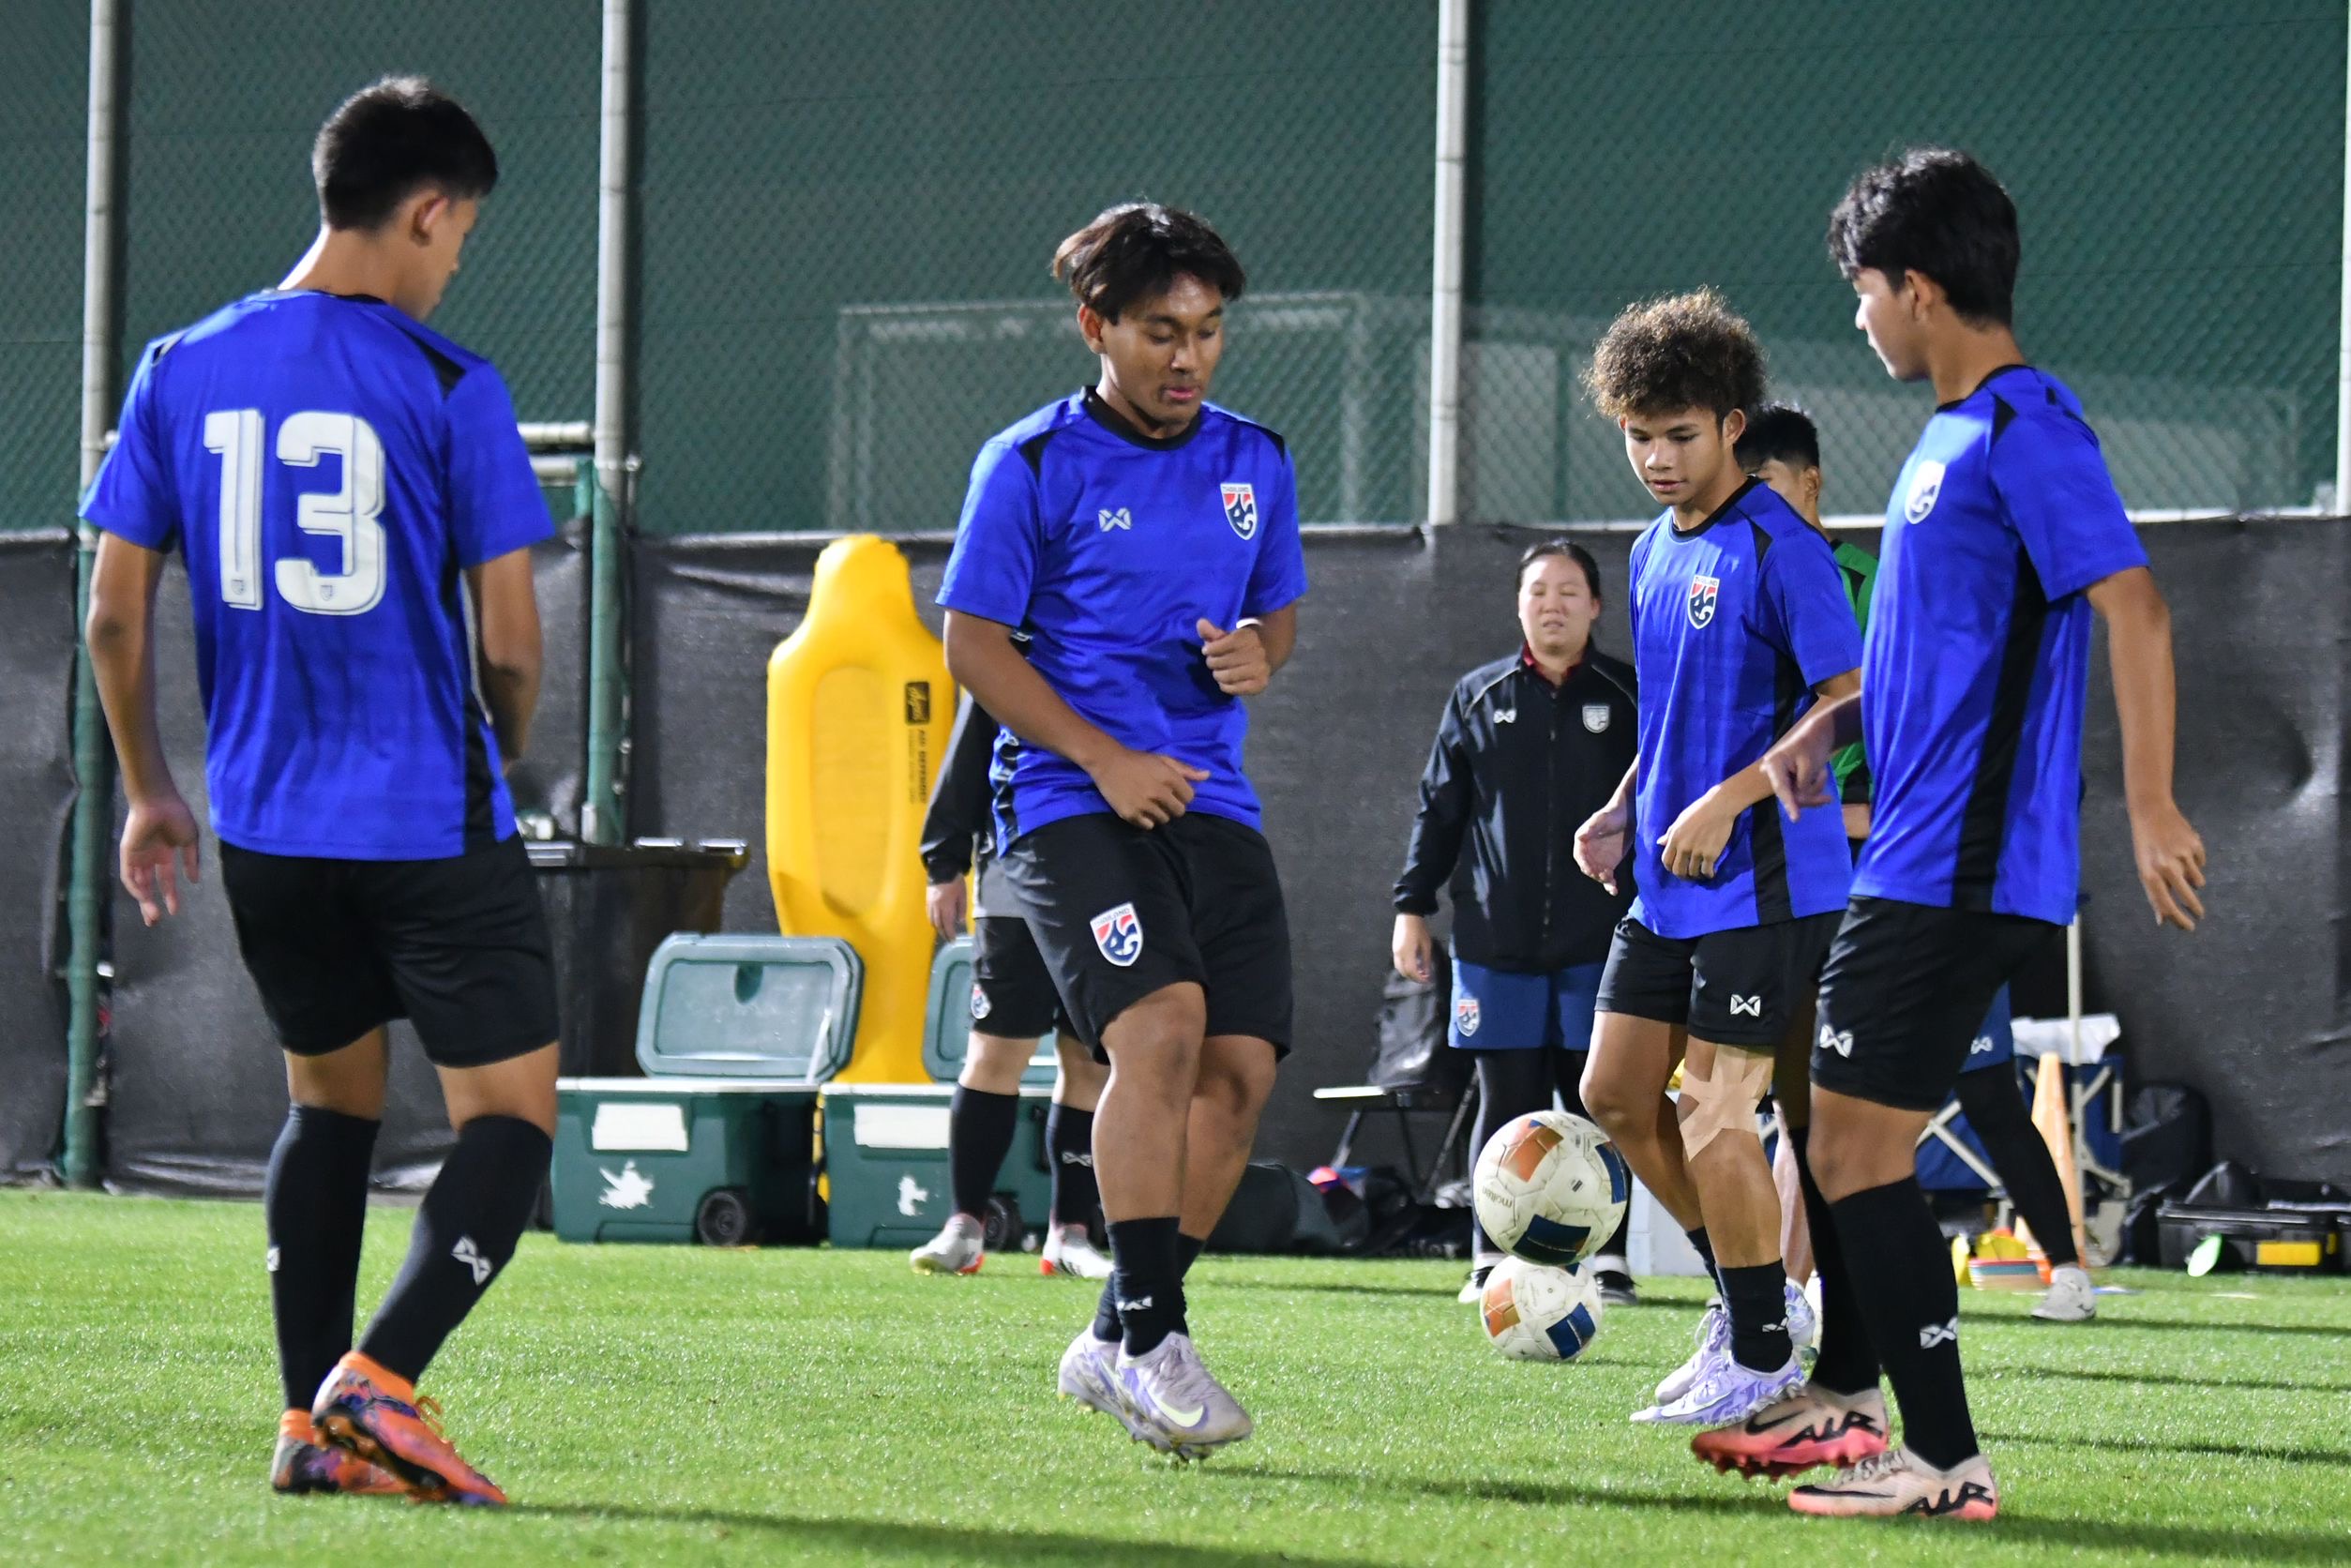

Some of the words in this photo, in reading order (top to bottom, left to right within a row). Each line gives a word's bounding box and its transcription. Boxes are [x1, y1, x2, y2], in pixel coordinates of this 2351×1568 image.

[203, 407, 386, 615] 13
[1482, 1185, 1512, 1208] molten
[1778, 1411, 1882, 1448] AIR
[1898, 1482, 1993, 1516] AIR
